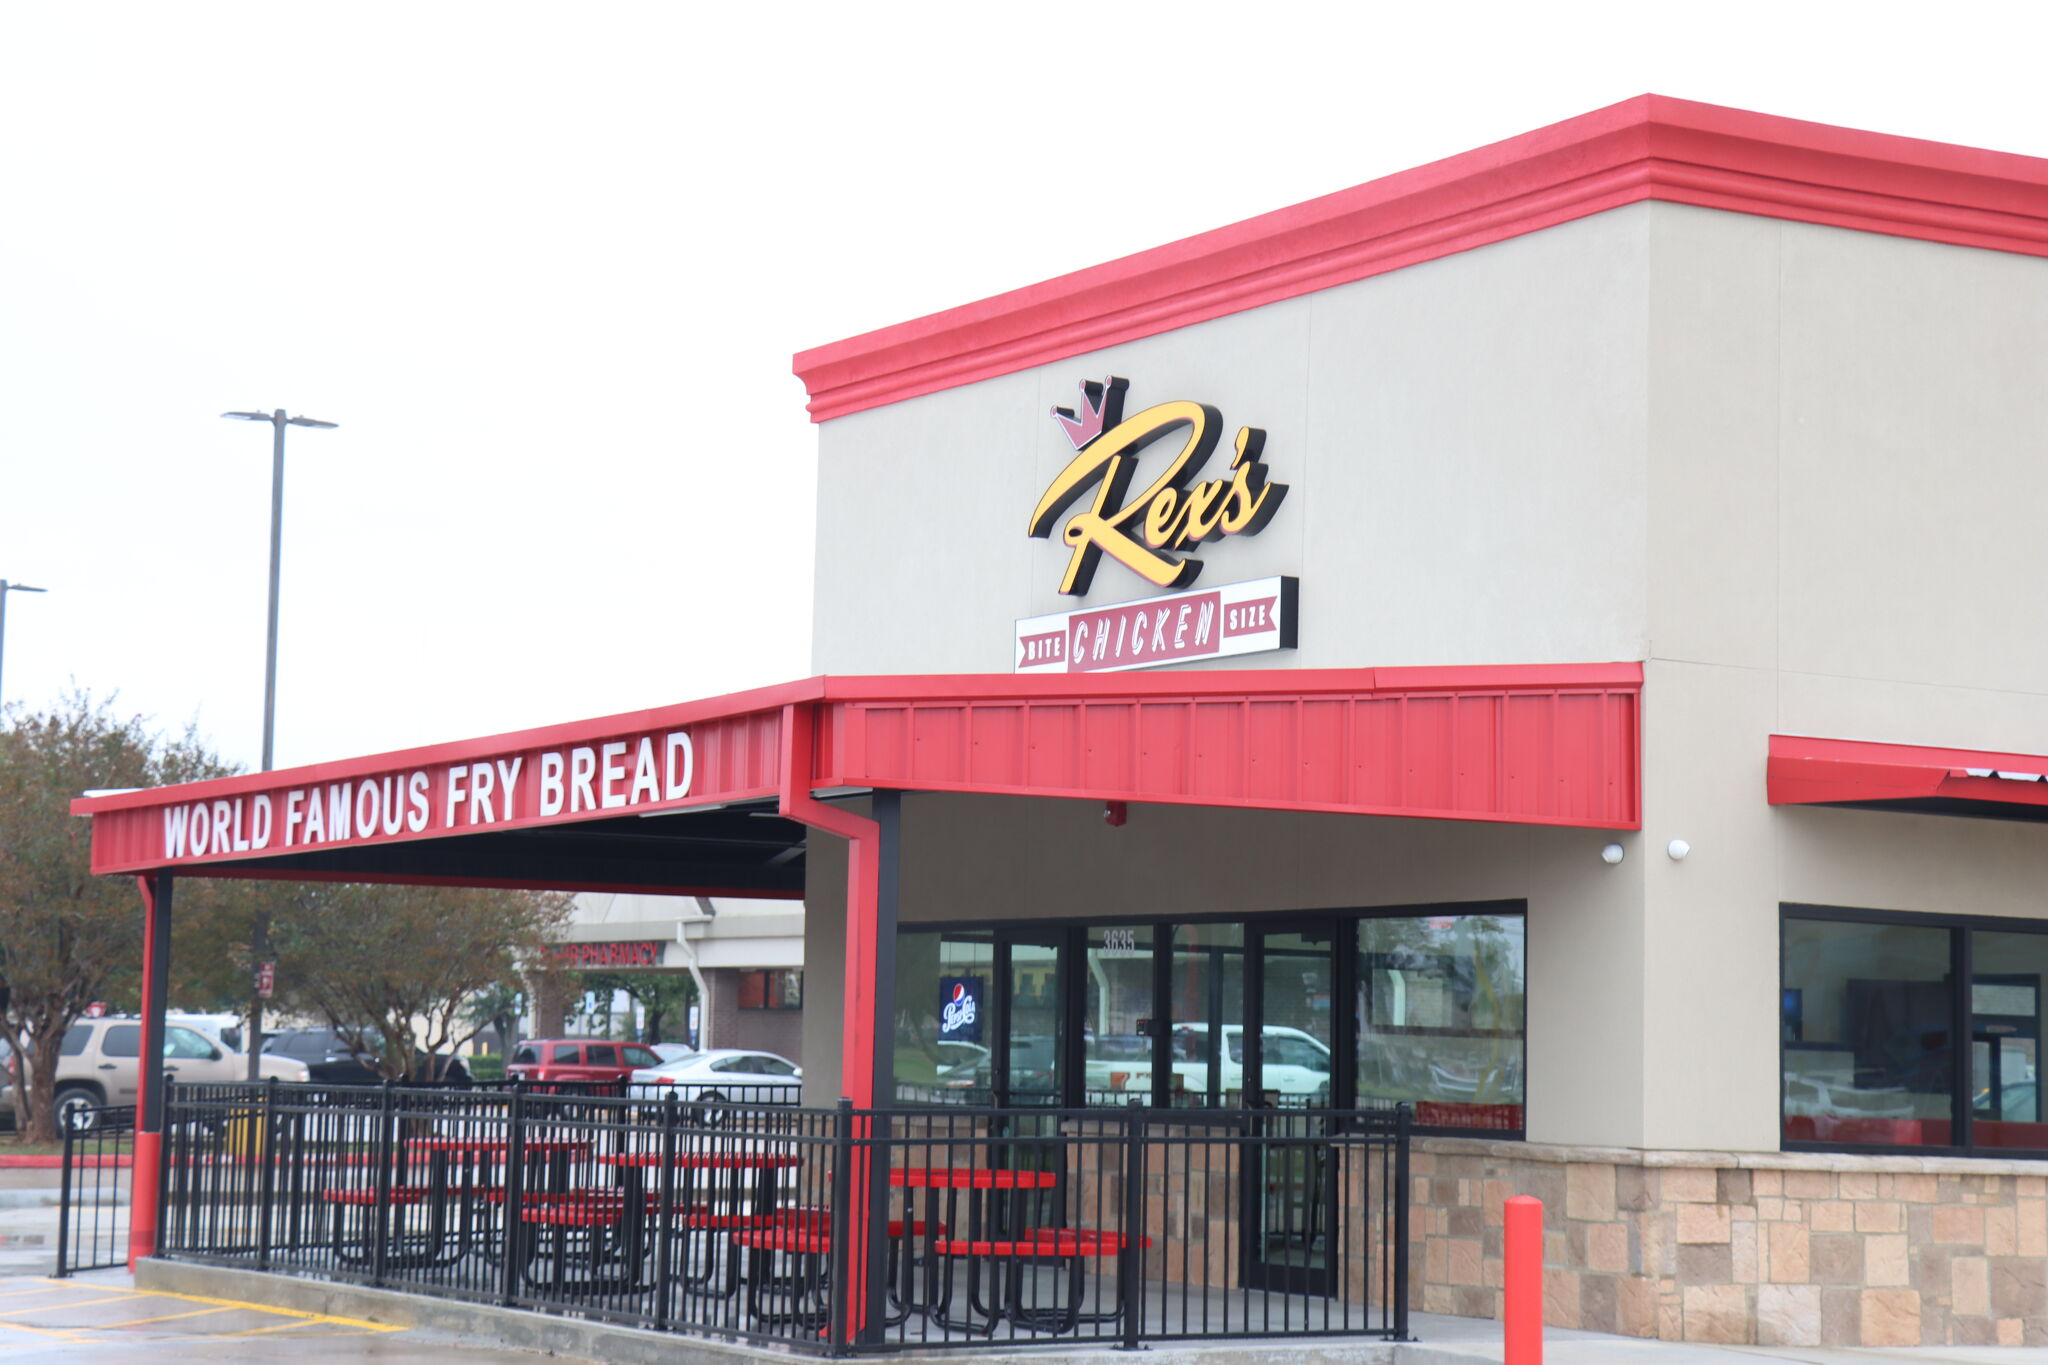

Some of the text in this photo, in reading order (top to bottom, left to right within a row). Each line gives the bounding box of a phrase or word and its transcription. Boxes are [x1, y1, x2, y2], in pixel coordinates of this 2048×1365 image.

[1028, 400, 1274, 595] Rex's
[1028, 600, 1266, 664] BITE CHICKEN SIZE
[164, 732, 694, 859] WORLD FAMOUS FRY BREAD
[581, 943, 658, 967] PHARMACY
[1103, 929, 1135, 957] 3635
